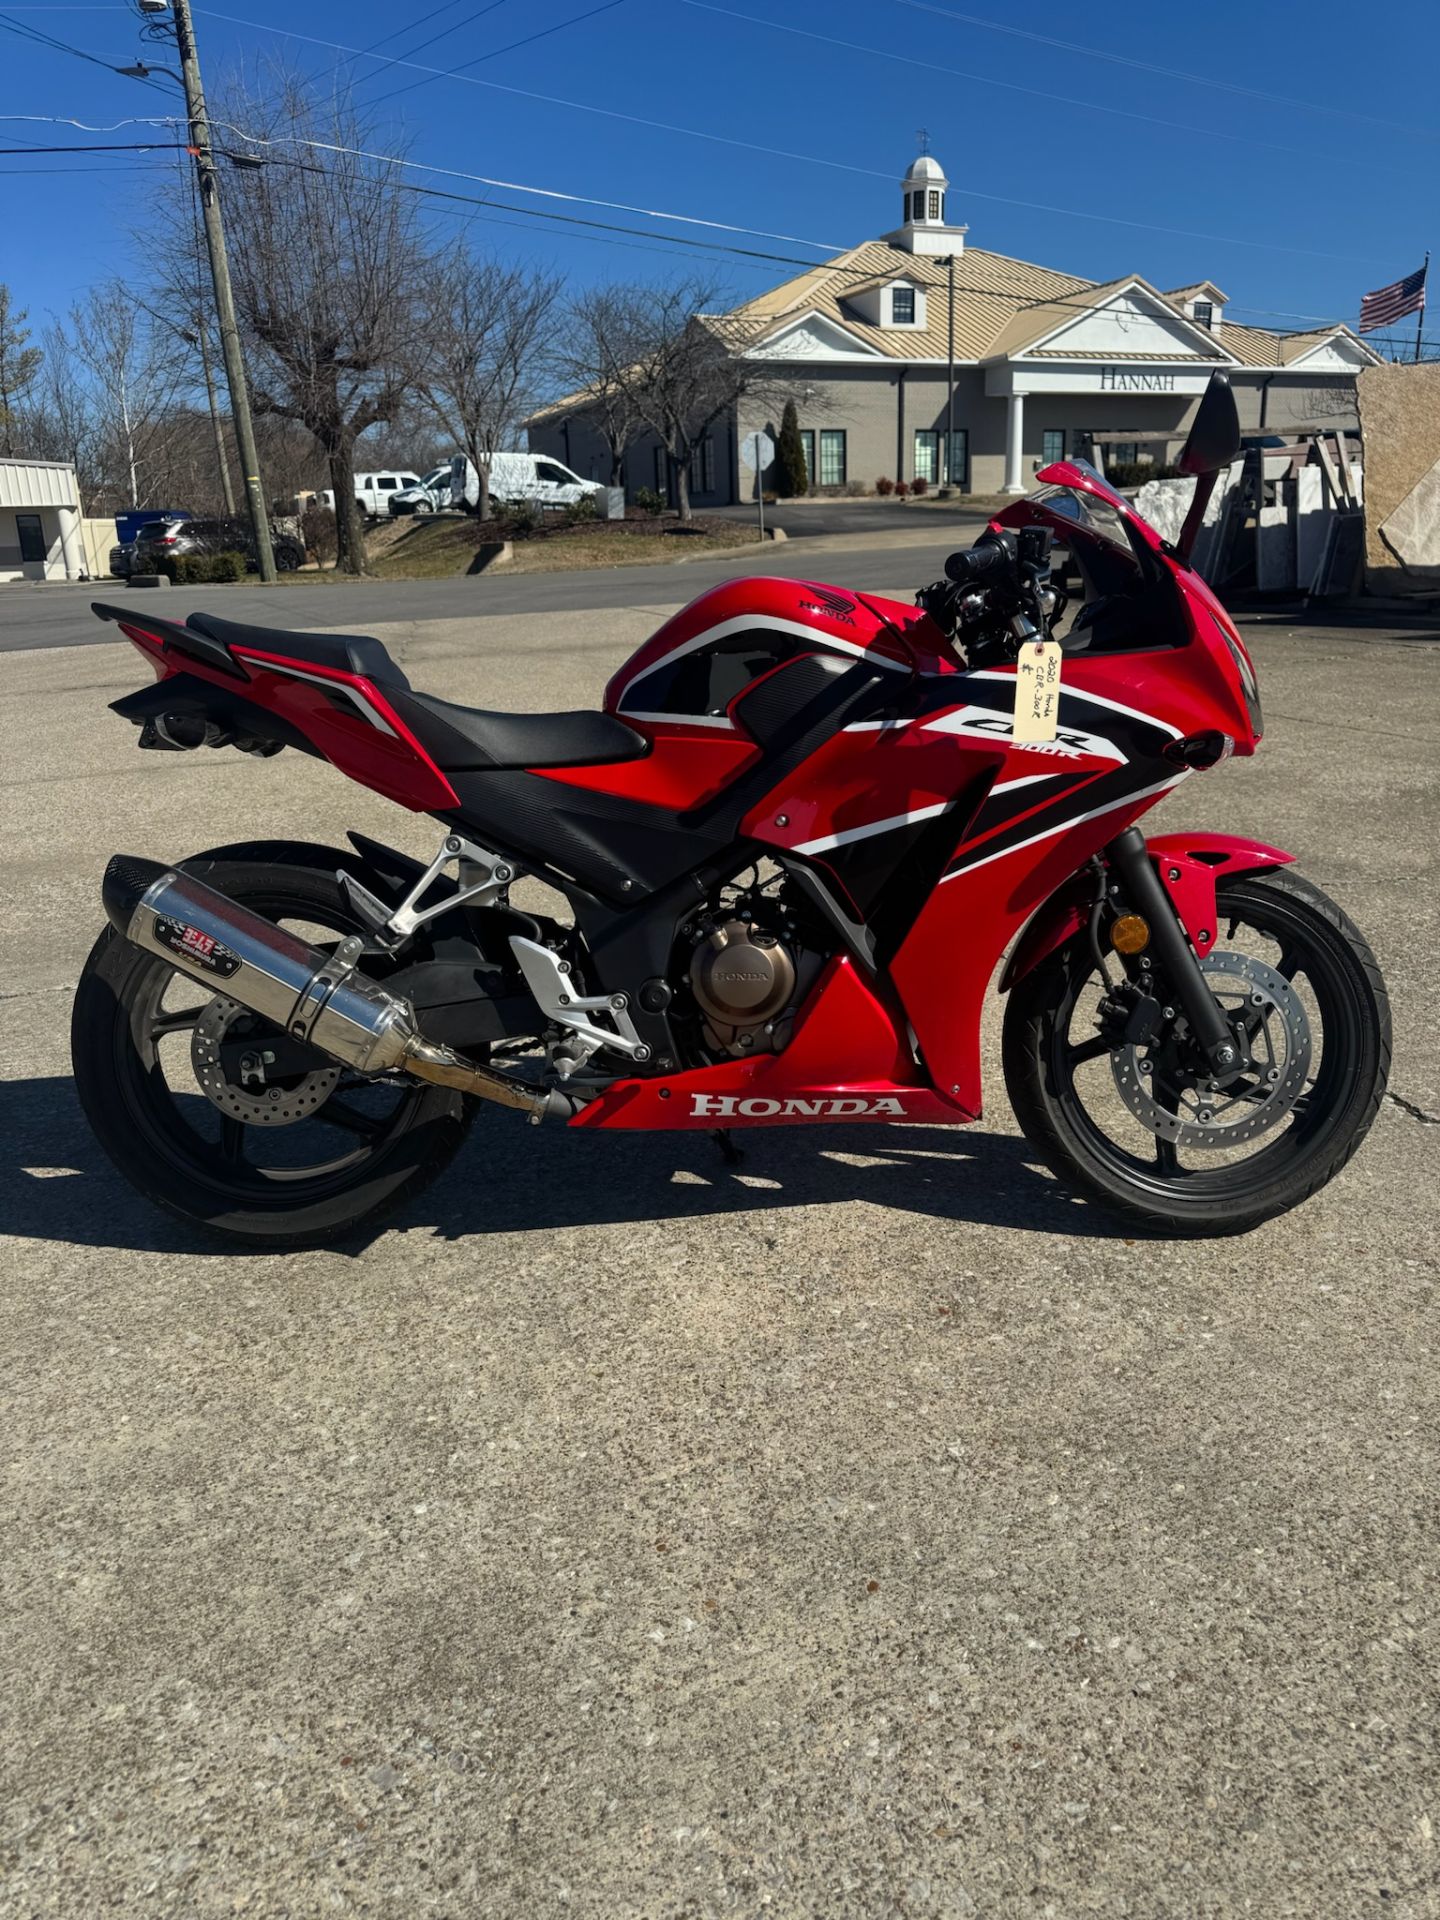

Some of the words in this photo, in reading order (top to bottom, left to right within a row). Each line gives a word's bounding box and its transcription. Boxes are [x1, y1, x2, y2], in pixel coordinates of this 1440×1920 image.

[1100, 367, 1175, 391] HANNAH
[1047, 656, 1057, 683] 2020
[961, 719, 1093, 753] CR
[714, 971, 768, 982] HONDA
[689, 1093, 908, 1117] HONDA
